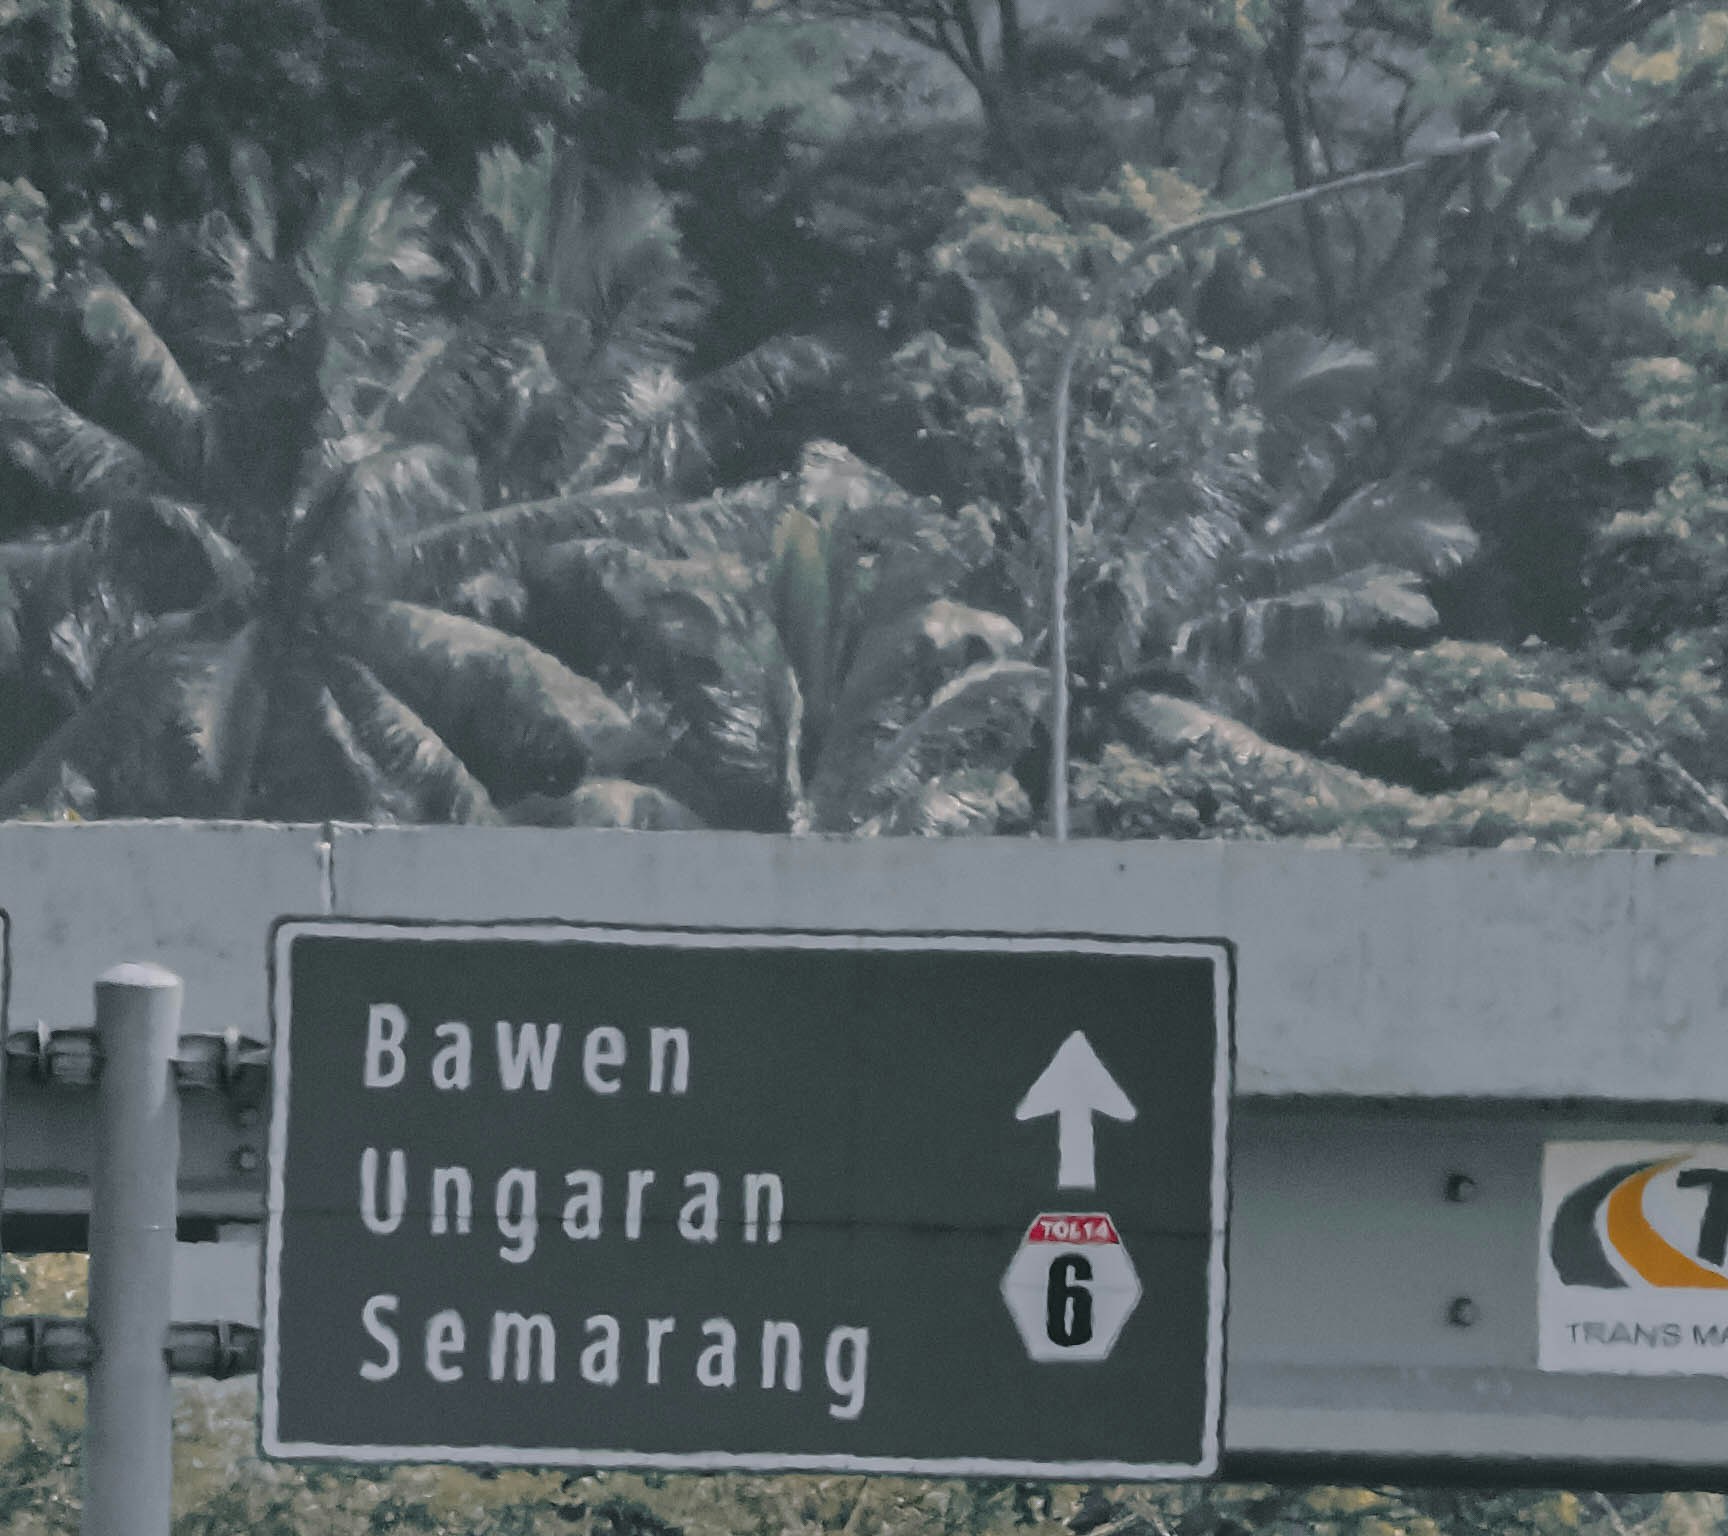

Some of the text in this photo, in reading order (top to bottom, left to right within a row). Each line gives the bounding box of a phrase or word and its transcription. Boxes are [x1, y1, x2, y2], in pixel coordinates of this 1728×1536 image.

[362, 1003, 691, 1095] Bawen
[358, 1147, 785, 1264] Ungaran
[1046, 1253, 1094, 1347] 6
[1566, 1321, 1682, 1349] TRANS
[359, 1294, 871, 1422] Semarang
